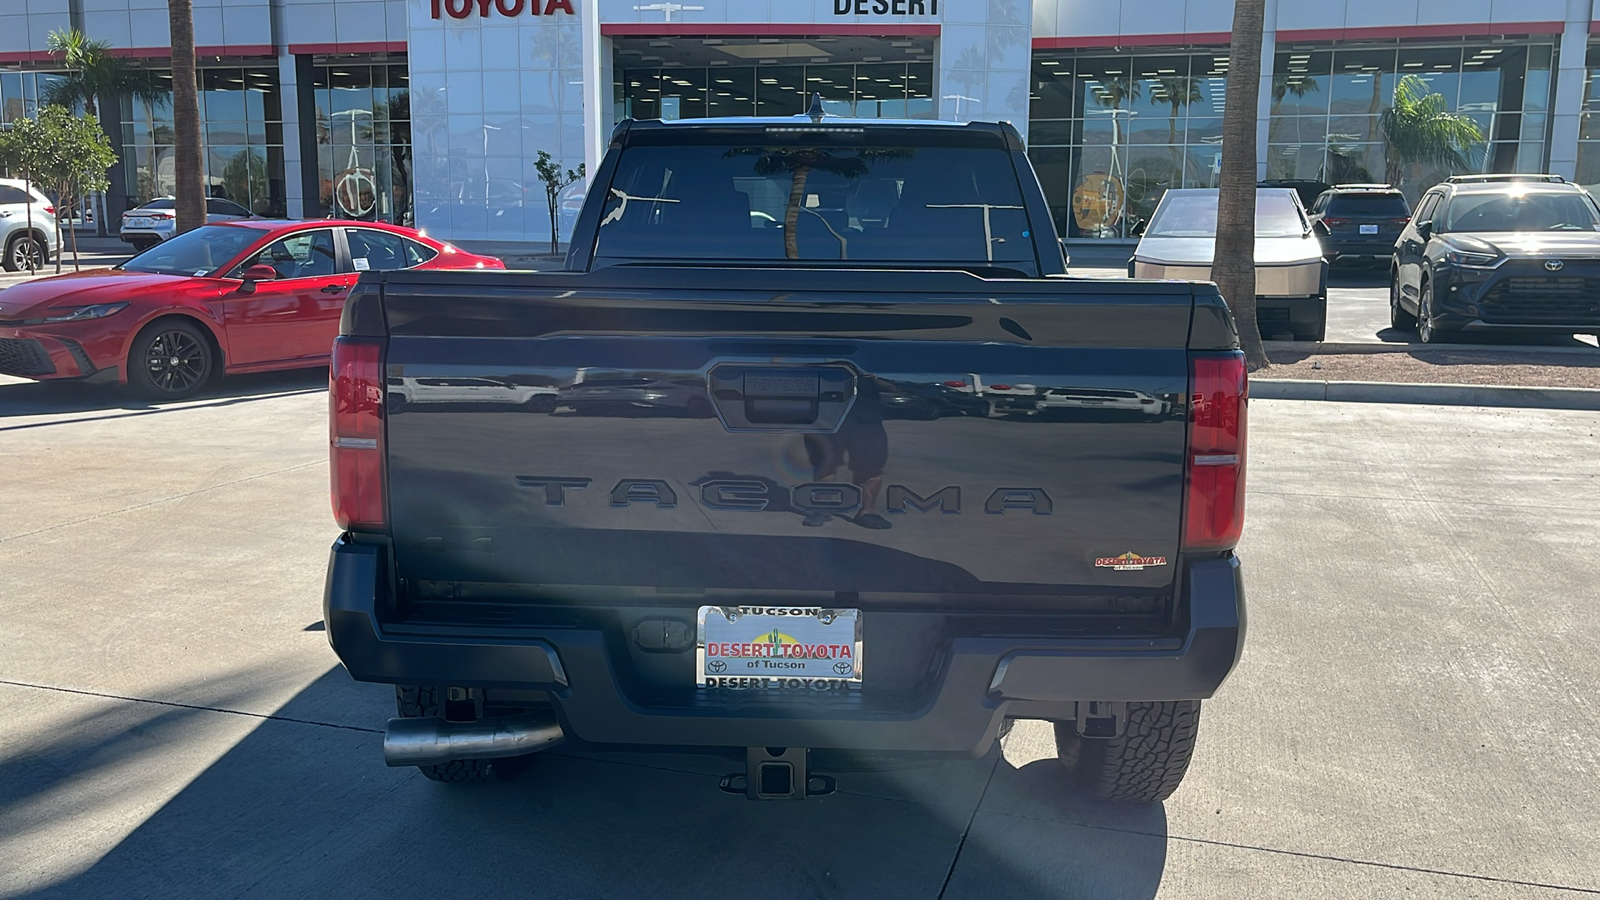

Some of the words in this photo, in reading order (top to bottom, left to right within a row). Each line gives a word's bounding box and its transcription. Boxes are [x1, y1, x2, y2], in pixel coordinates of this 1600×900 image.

[431, 0, 574, 19] TOYOTA
[834, 0, 938, 15] DESERT
[747, 378, 816, 392] TOYOTA
[515, 475, 1054, 516] TACOMA
[741, 607, 818, 616] TUCSON
[708, 643, 774, 657] DESERT
[781, 643, 852, 658] TOYOTA
[747, 660, 759, 669] of
[762, 660, 806, 669] Tucson
[706, 677, 770, 689] DESERT
[779, 678, 850, 690] TOYOTA
